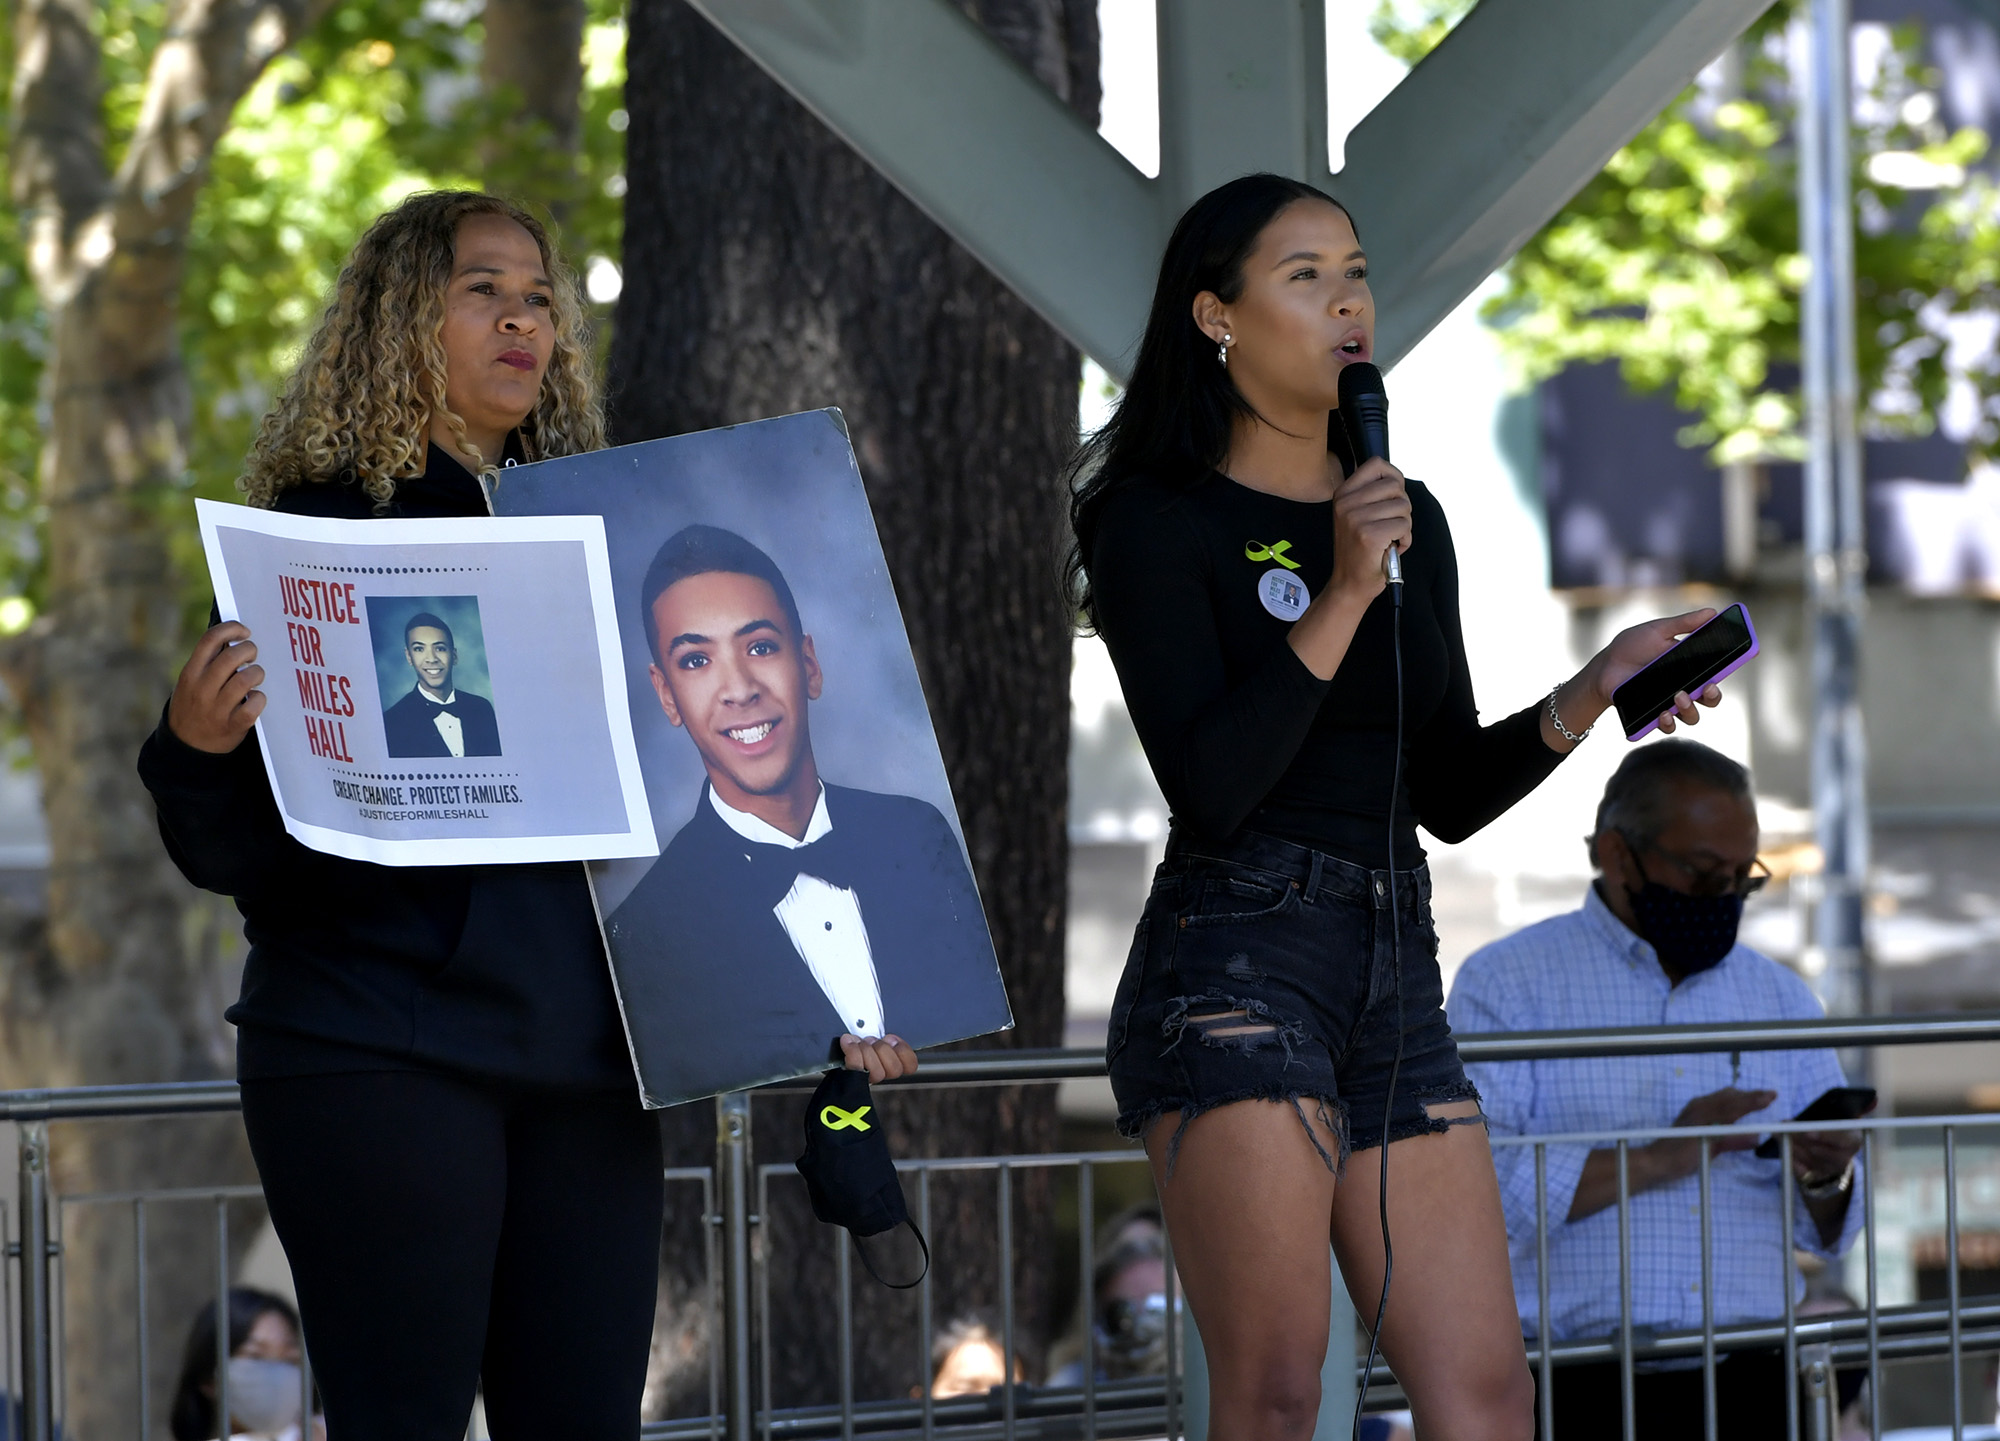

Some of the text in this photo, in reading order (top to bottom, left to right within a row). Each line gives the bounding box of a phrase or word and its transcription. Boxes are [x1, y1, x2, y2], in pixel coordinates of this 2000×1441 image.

[278, 574, 360, 625] JUSTICE
[287, 622, 325, 668] FOR
[295, 668, 355, 718] MILES
[304, 715, 354, 763] HALL
[333, 779, 523, 806] CREATE CHANGE. PROTECT FAMILIES.
[358, 807, 489, 821] #JUSTICEFORMILESHALL
